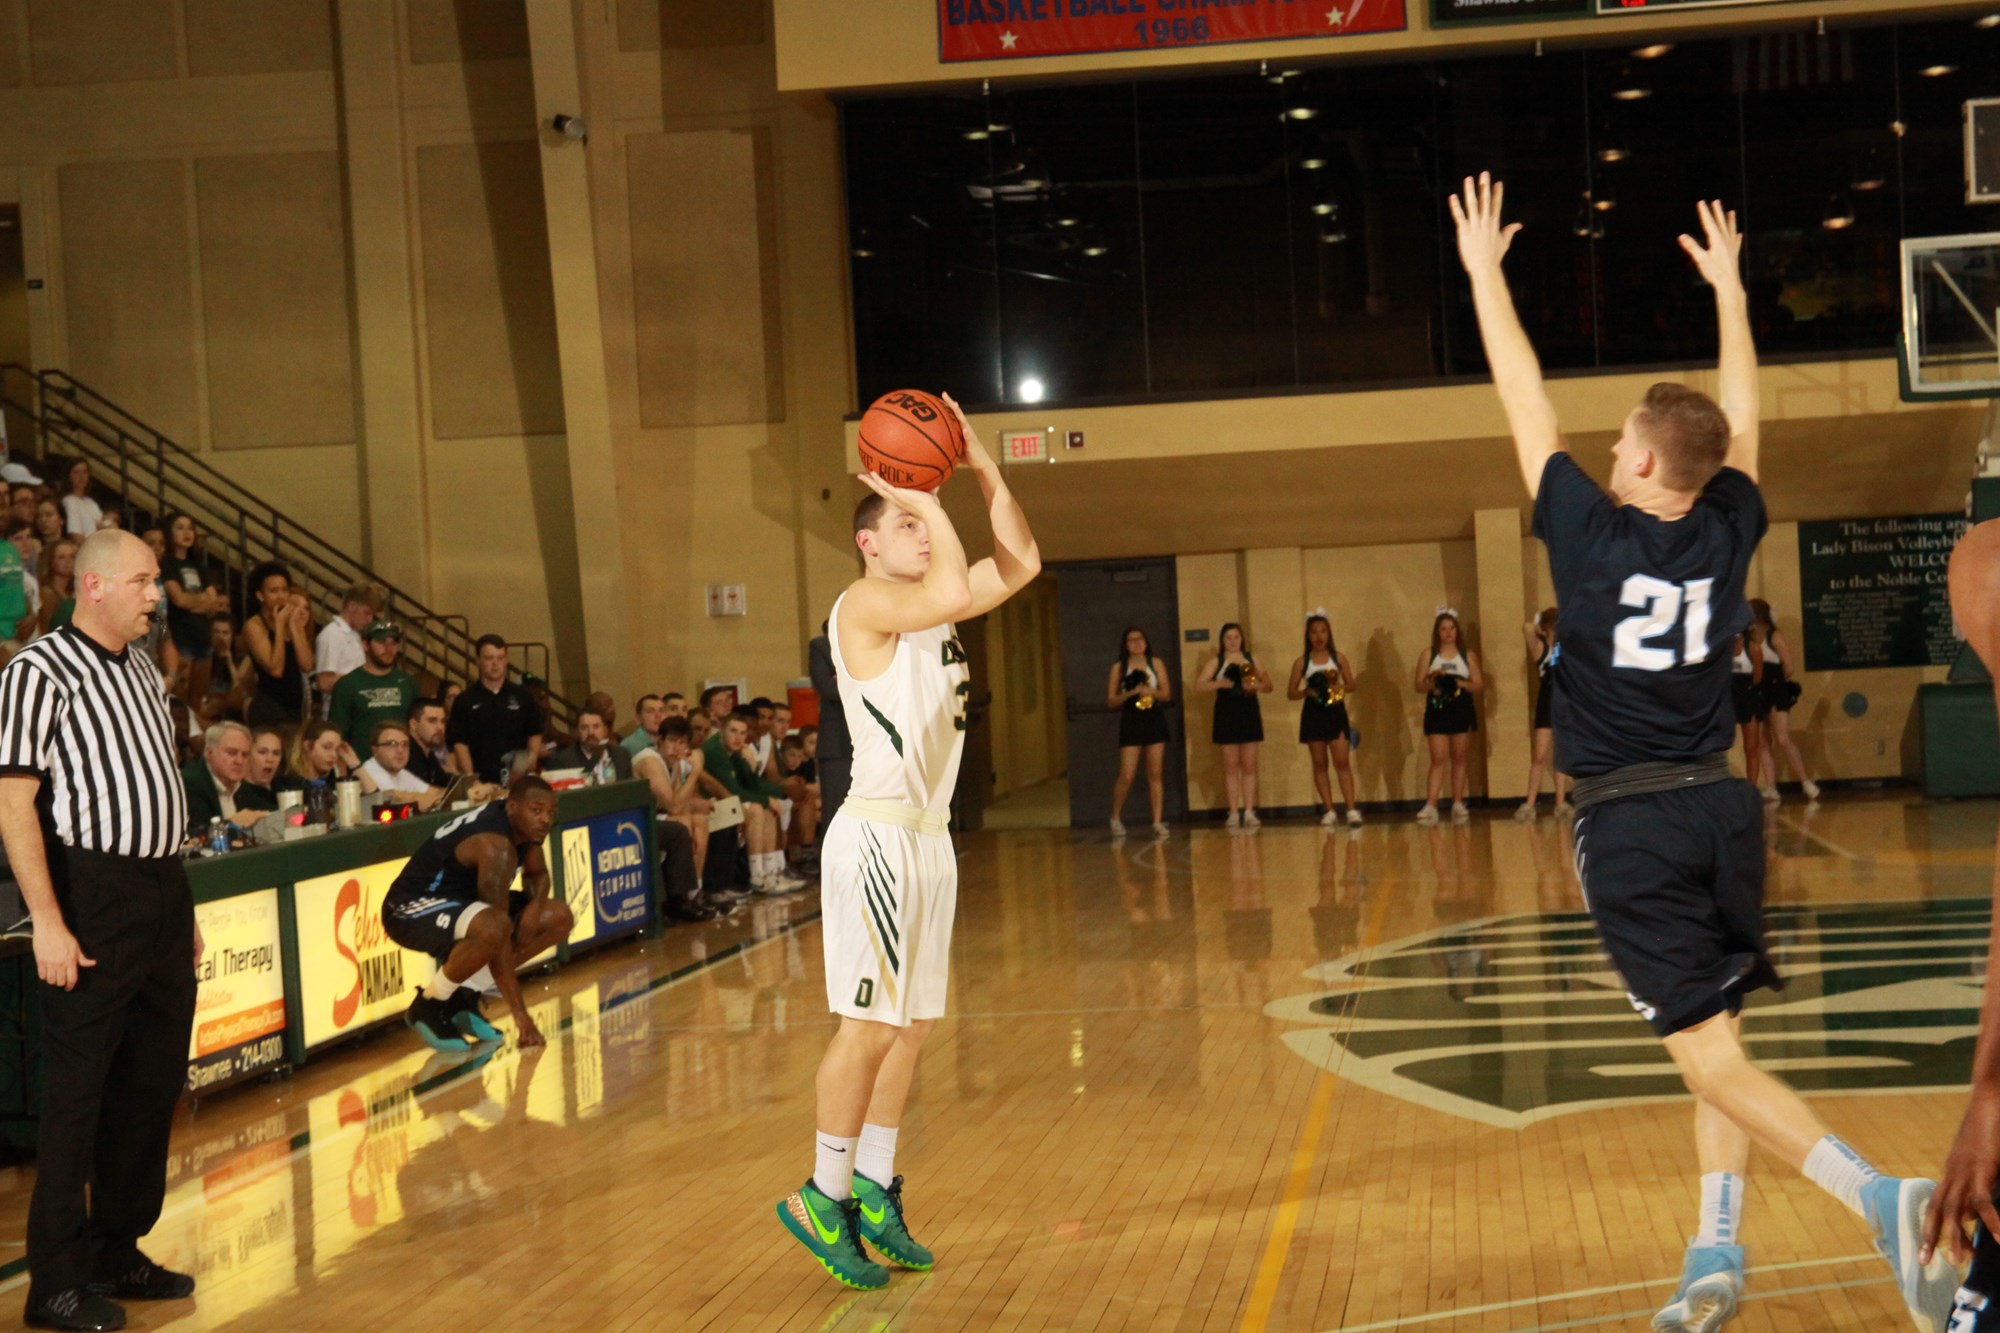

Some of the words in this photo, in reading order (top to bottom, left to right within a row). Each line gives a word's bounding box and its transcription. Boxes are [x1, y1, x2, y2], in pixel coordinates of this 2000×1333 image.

[1133, 16, 1209, 43] 1966
[1011, 436, 1039, 458] EXIT
[879, 461, 914, 484] ROCK
[1841, 521, 1870, 535] The
[1874, 519, 1942, 534] following
[1812, 541, 1846, 555] Lady
[1851, 539, 1893, 553] Bison
[1830, 578, 1845, 590] to
[1849, 574, 1872, 588] the
[1876, 570, 1921, 587] Noble
[1612, 572, 1714, 671] 21
[599, 870, 643, 898] COMPANY
[223, 943, 274, 975] Therapy
[359, 948, 405, 1006] YAMAHA
[187, 1058, 232, 1091] Shawnee
[240, 1034, 284, 1072] 214-0300
